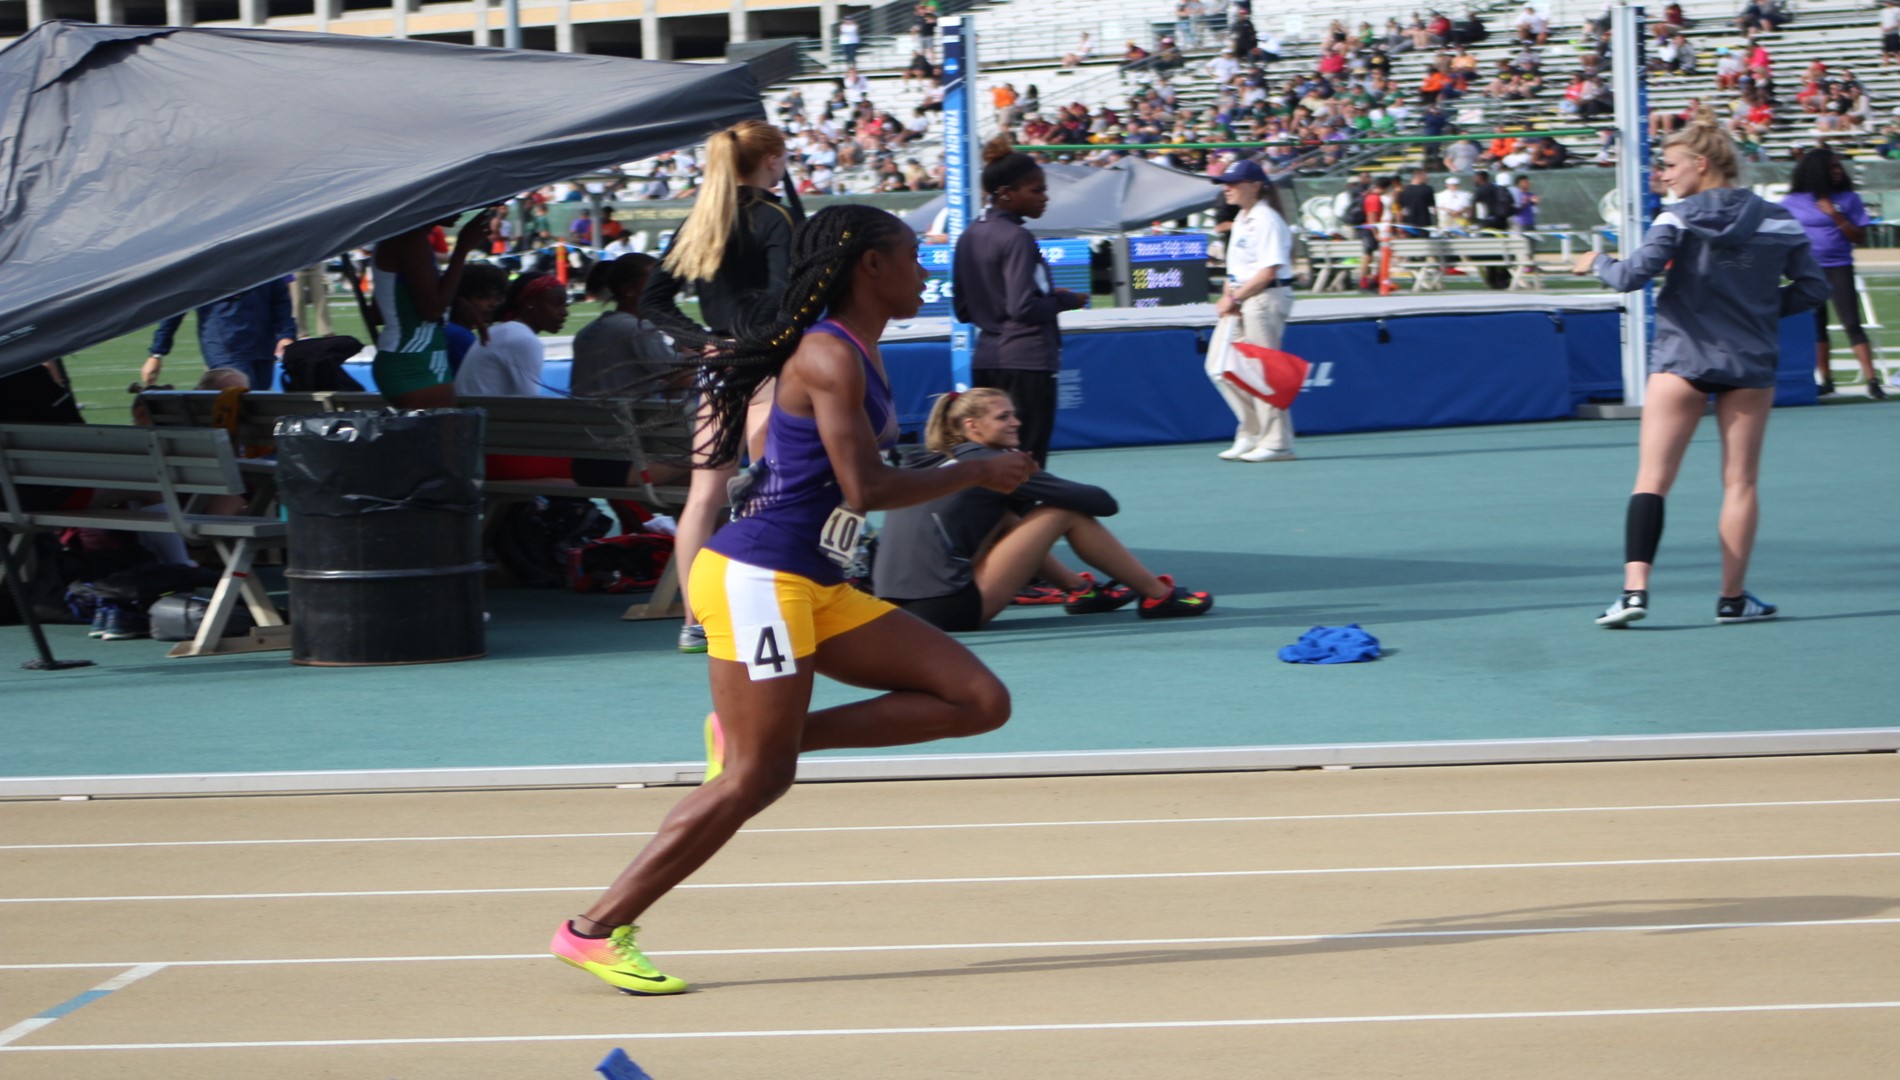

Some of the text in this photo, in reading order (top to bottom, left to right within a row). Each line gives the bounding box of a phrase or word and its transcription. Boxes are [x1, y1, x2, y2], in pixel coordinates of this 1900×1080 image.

[945, 109, 961, 153] TRACK
[947, 167, 963, 205] FIELD
[1300, 362, 1334, 387] LL
[823, 511, 859, 553] 10
[754, 625, 786, 674] 4
